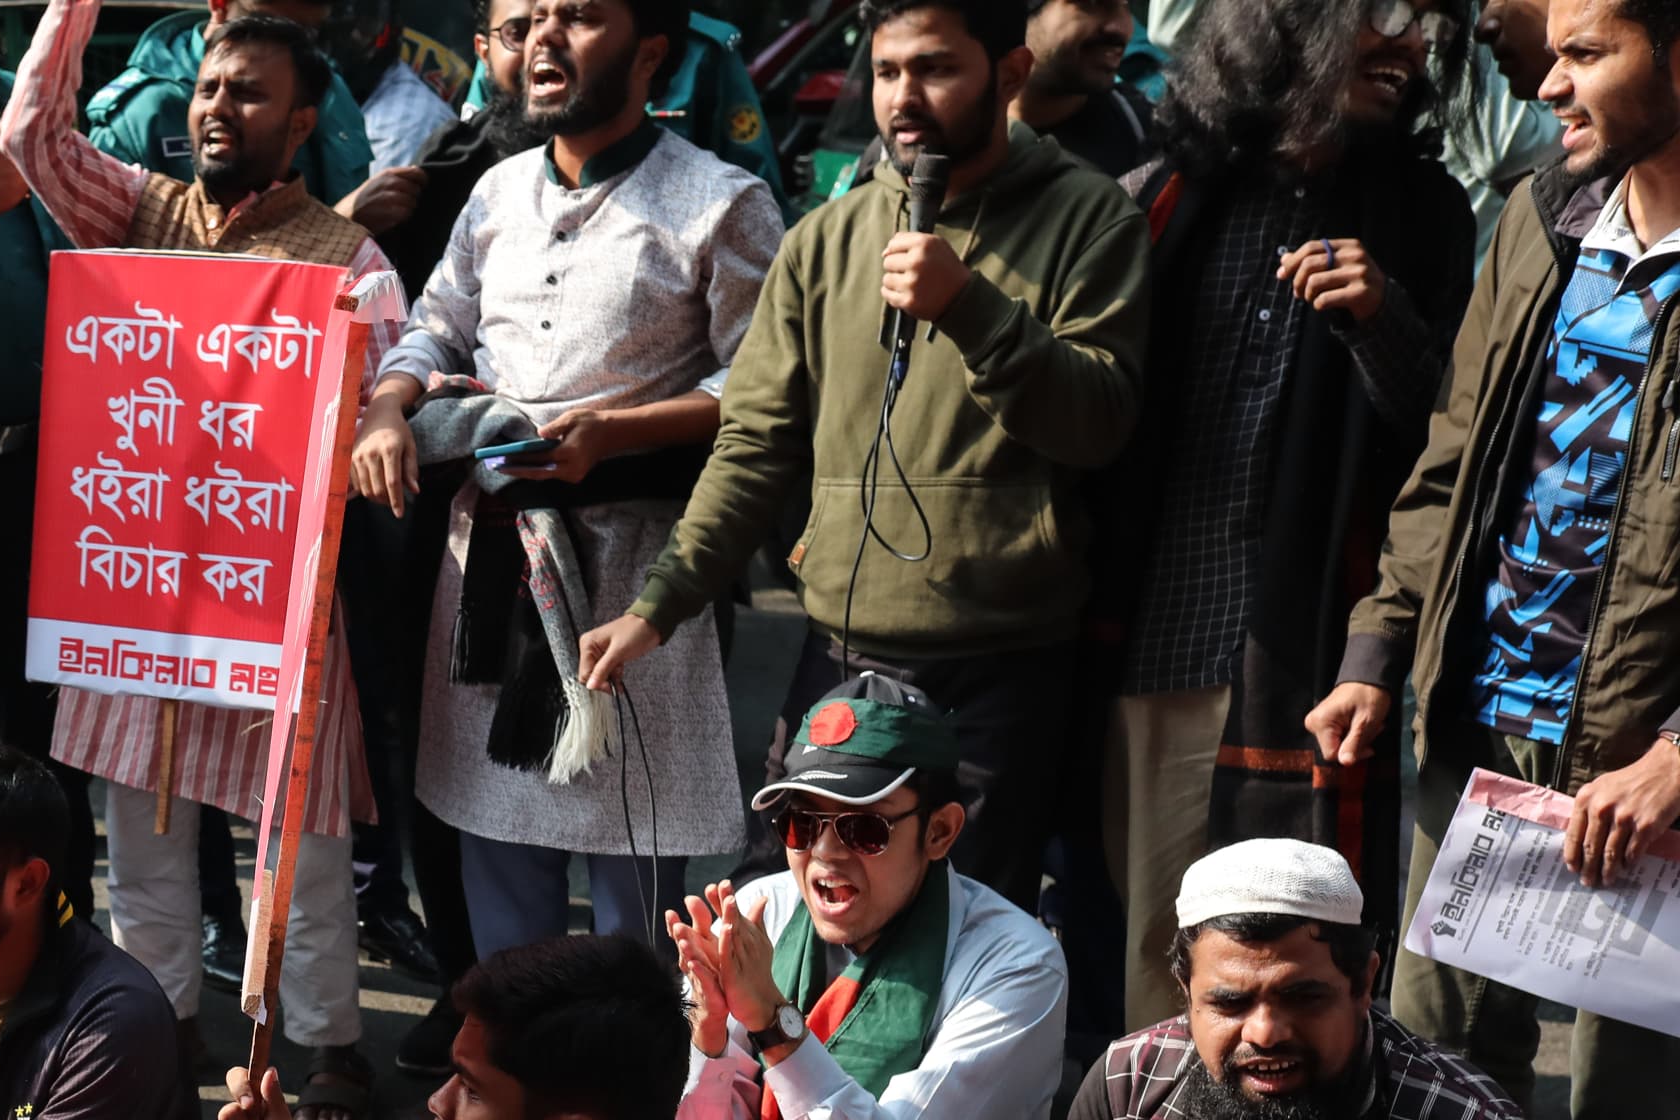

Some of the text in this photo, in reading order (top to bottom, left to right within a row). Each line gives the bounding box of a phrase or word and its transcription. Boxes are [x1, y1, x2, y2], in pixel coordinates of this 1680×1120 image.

[66, 301, 322, 378] একটা একটা
[107, 376, 263, 456] খুনী ধর
[70, 451, 295, 534] ধইরা ধইরা
[75, 525, 272, 606] বিচার কর
[58, 637, 217, 689] ইনকিলাব
[1441, 834, 1496, 922] ইনকিলাব
